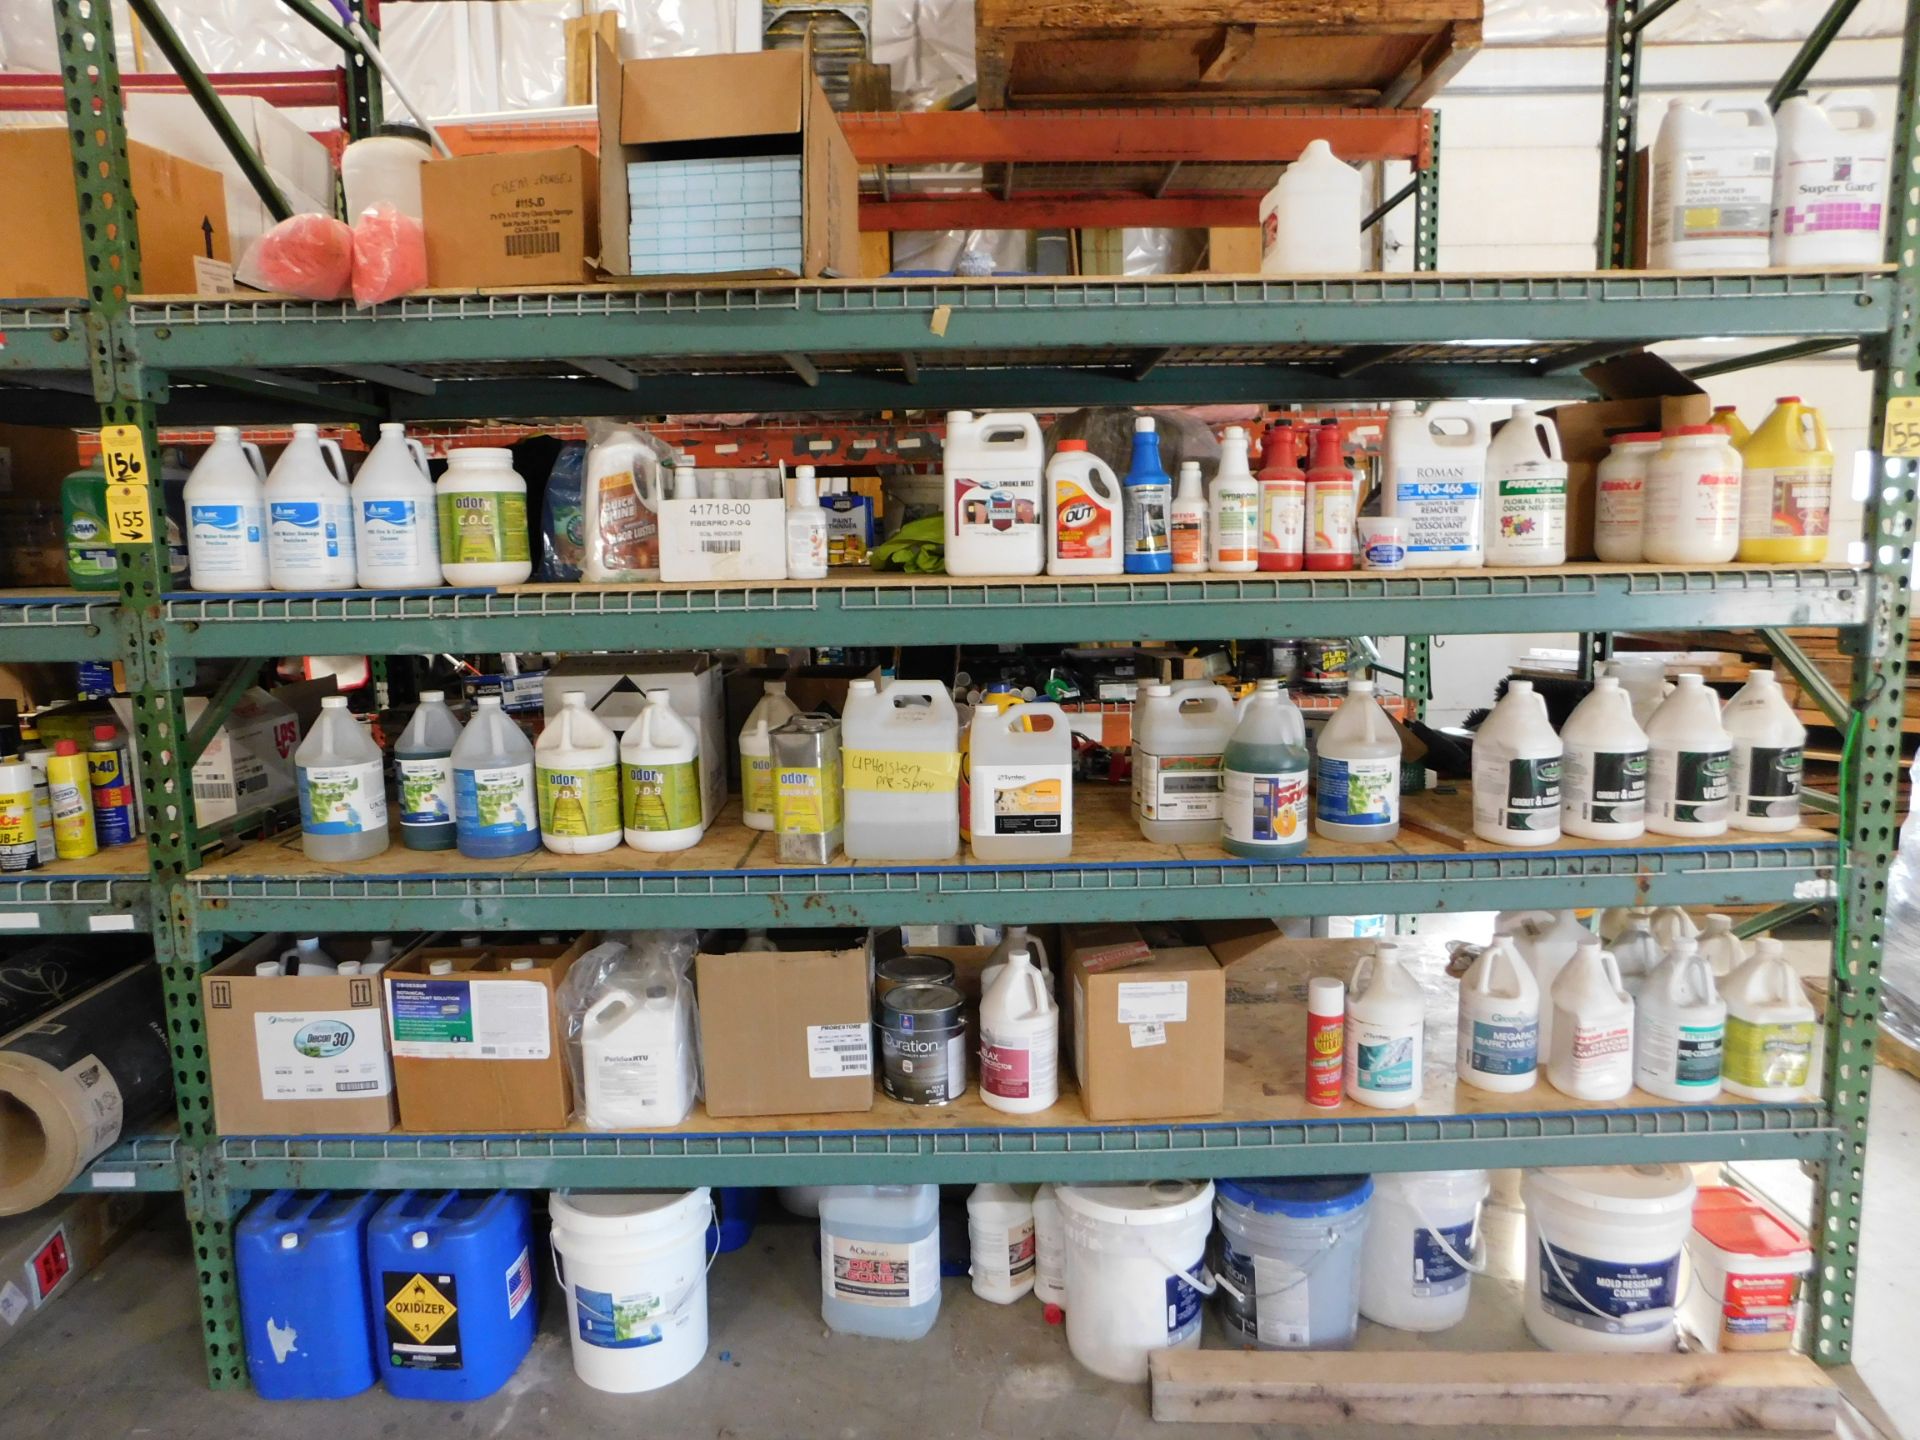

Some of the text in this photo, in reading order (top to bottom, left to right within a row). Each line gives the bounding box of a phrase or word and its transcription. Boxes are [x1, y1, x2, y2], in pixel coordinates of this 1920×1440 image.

[1799, 184, 1840, 195] Super
[108, 452, 141, 478] 156
[1417, 467, 1464, 478] ROMAN
[1417, 483, 1464, 494] PRO-466
[689, 503, 751, 515] 41718-00
[1066, 506, 1094, 522] OUT
[1421, 506, 1459, 514] REMOVER
[115, 511, 144, 529] 155
[752, 760, 770, 769] odo
[1621, 789, 1628, 799] &
[1535, 795, 1541, 806] &
[307, 1032, 349, 1047] Decon 30
[884, 1032, 939, 1054] Duration
[1475, 1037, 1505, 1049] TRAFFIC
[1507, 1041, 1525, 1049] LANE
[79, 1072, 94, 1089] USA
[849, 1259, 872, 1270] ON
[847, 1270, 896, 1284] GONE
[1596, 1277, 1663, 1289] MOLD RESISTANT
[1614, 1289, 1650, 1297] COATING
[395, 1303, 445, 1314] OXIDIZER
[414, 1323, 430, 1332] 5.1
